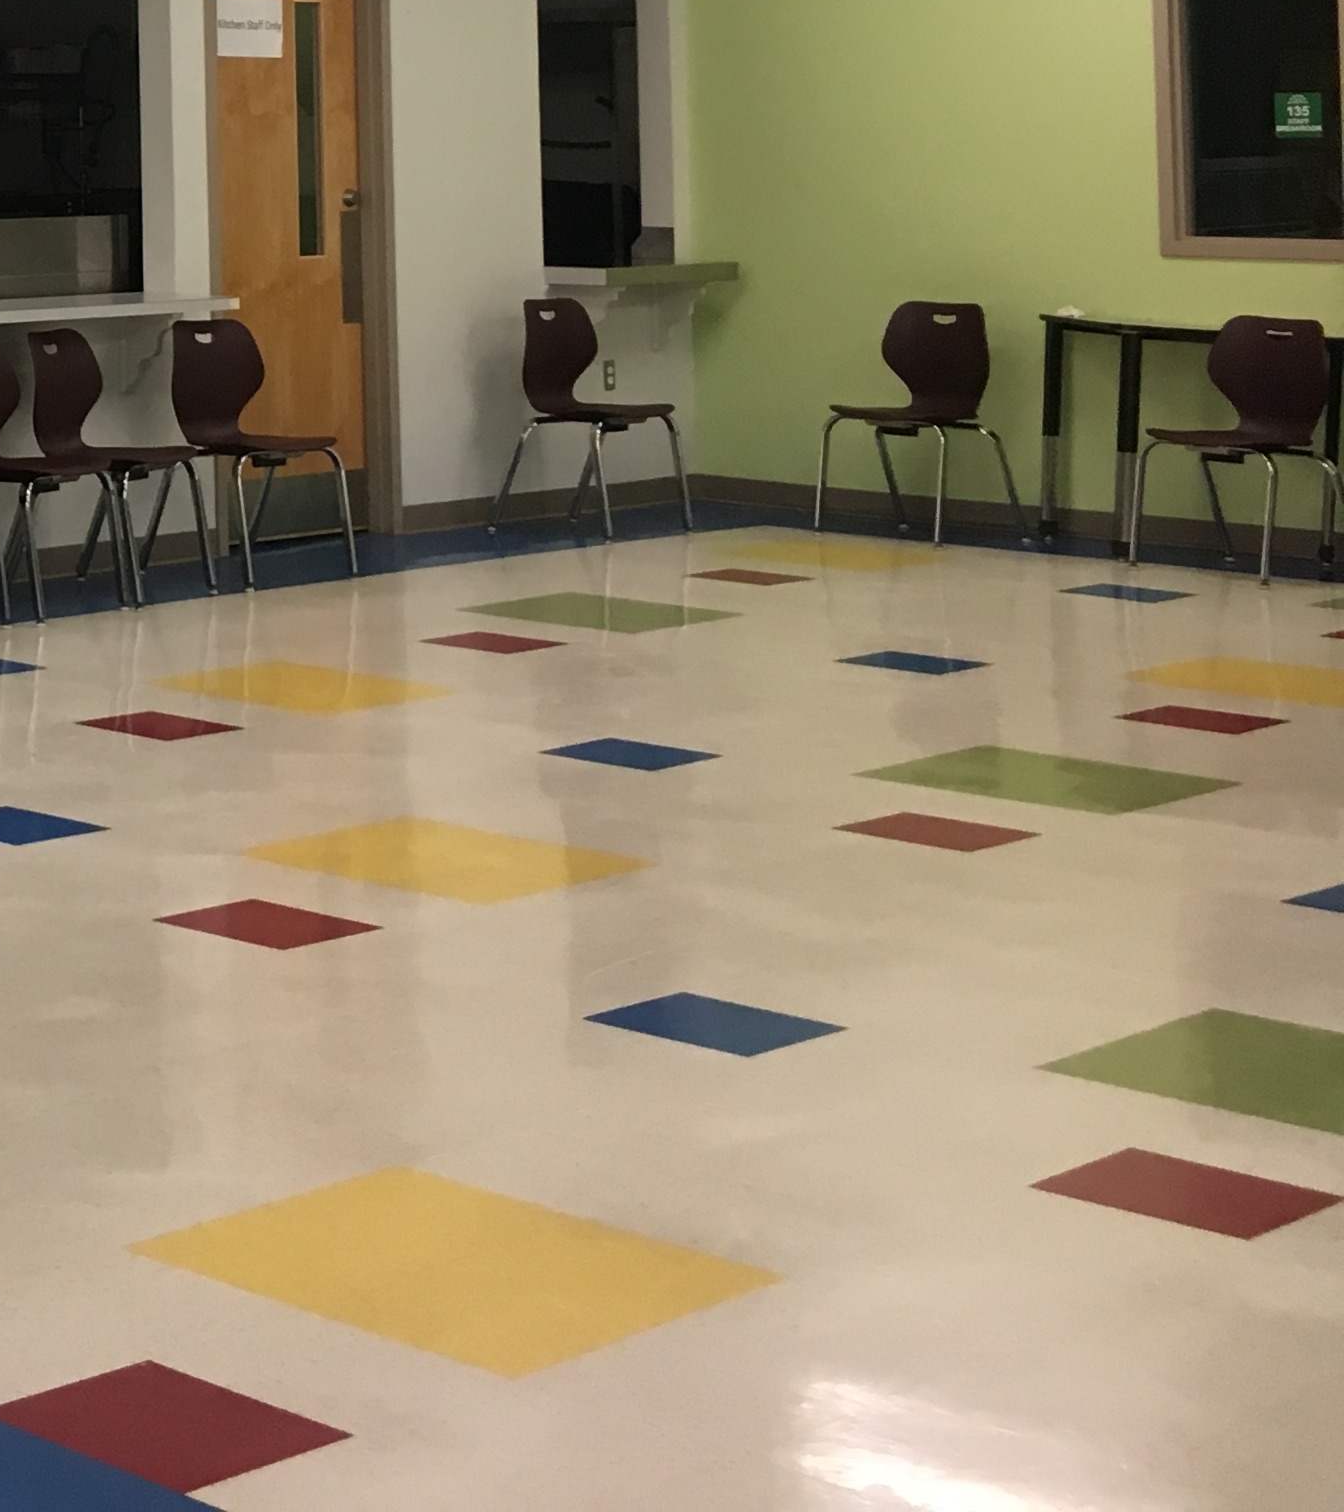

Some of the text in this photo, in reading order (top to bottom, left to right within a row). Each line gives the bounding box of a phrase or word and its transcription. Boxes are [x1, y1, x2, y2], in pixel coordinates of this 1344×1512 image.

[218, 19, 282, 33] Kitchen Staff Only
[1287, 105, 1310, 117] 135
